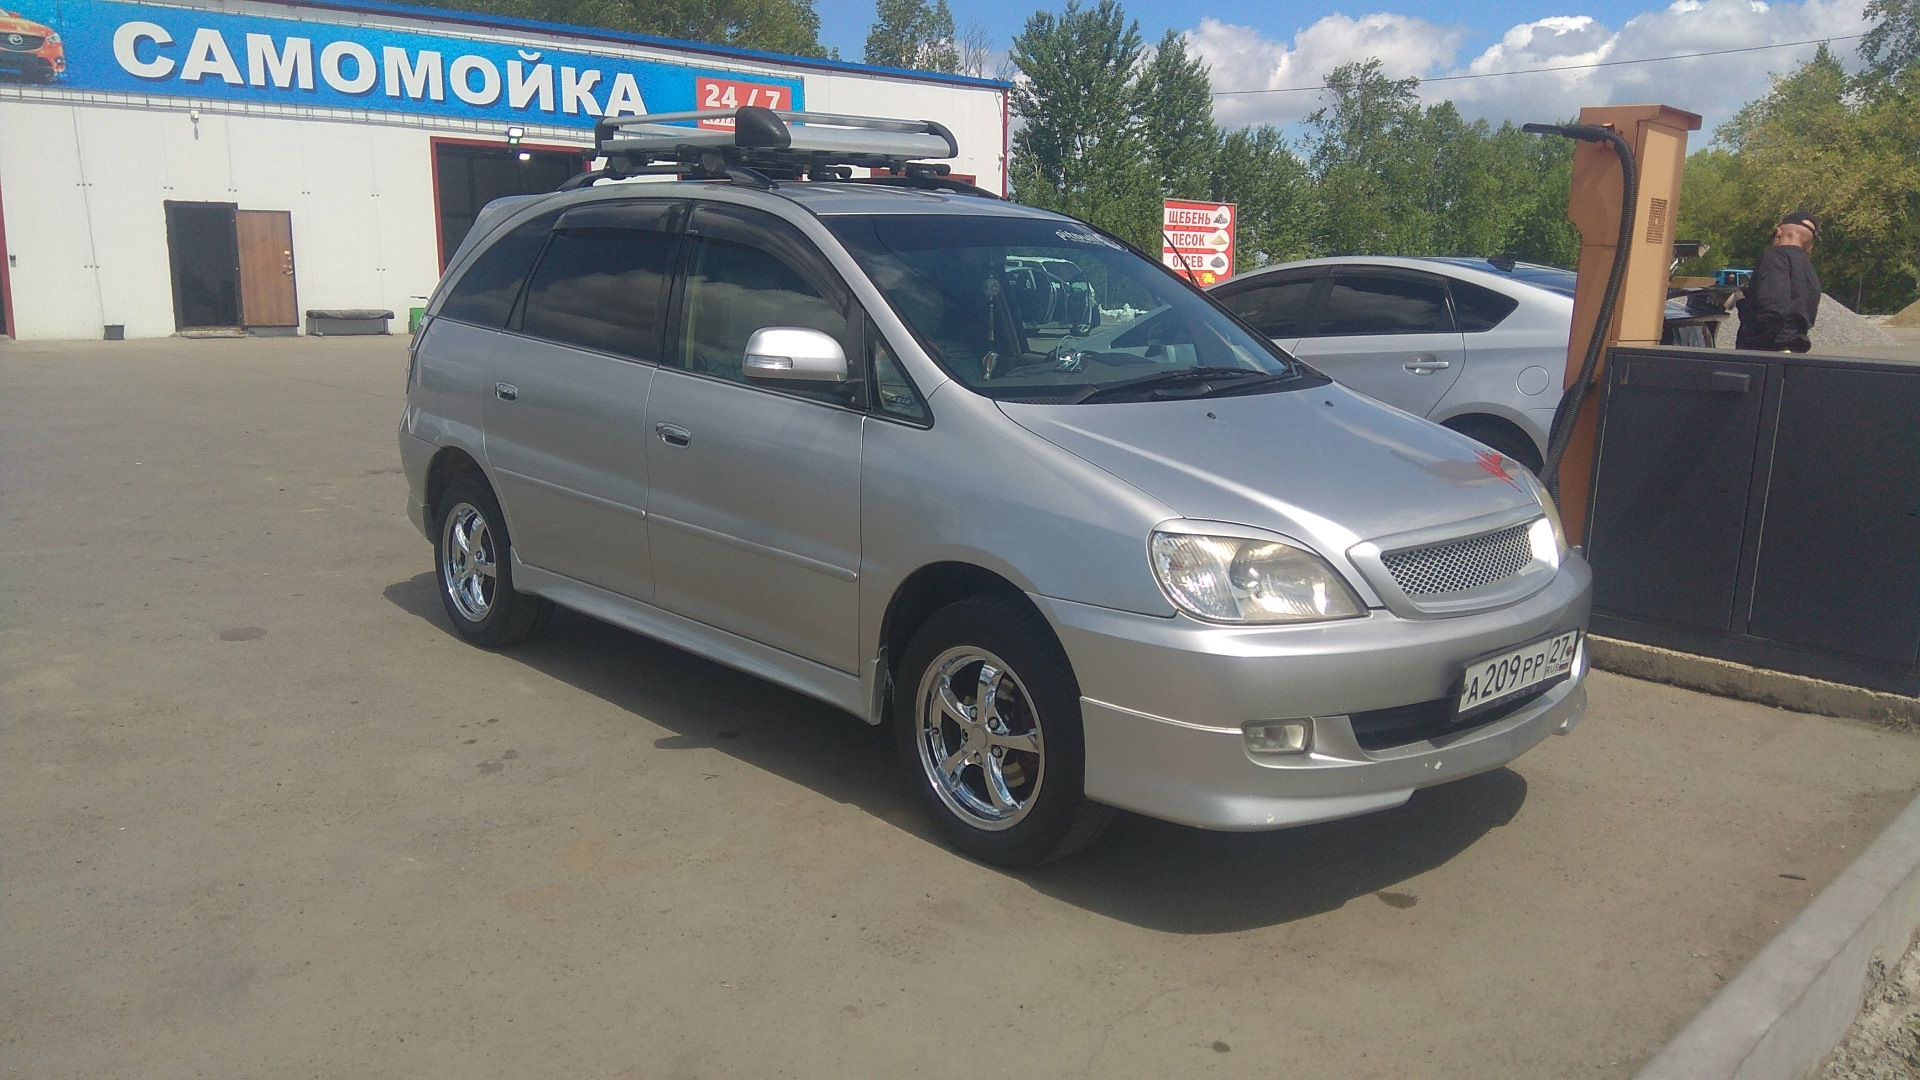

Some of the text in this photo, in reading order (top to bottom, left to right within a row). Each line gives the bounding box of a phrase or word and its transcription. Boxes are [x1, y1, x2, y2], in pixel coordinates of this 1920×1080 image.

[113, 21, 648, 117] САМОМОЙКА
[1168, 210, 1211, 226] ЩЕБЕНЬ
[1172, 233, 1205, 247] ПЕСОК
[1549, 635, 1570, 663] 27
[1545, 663, 1560, 674] RUS
